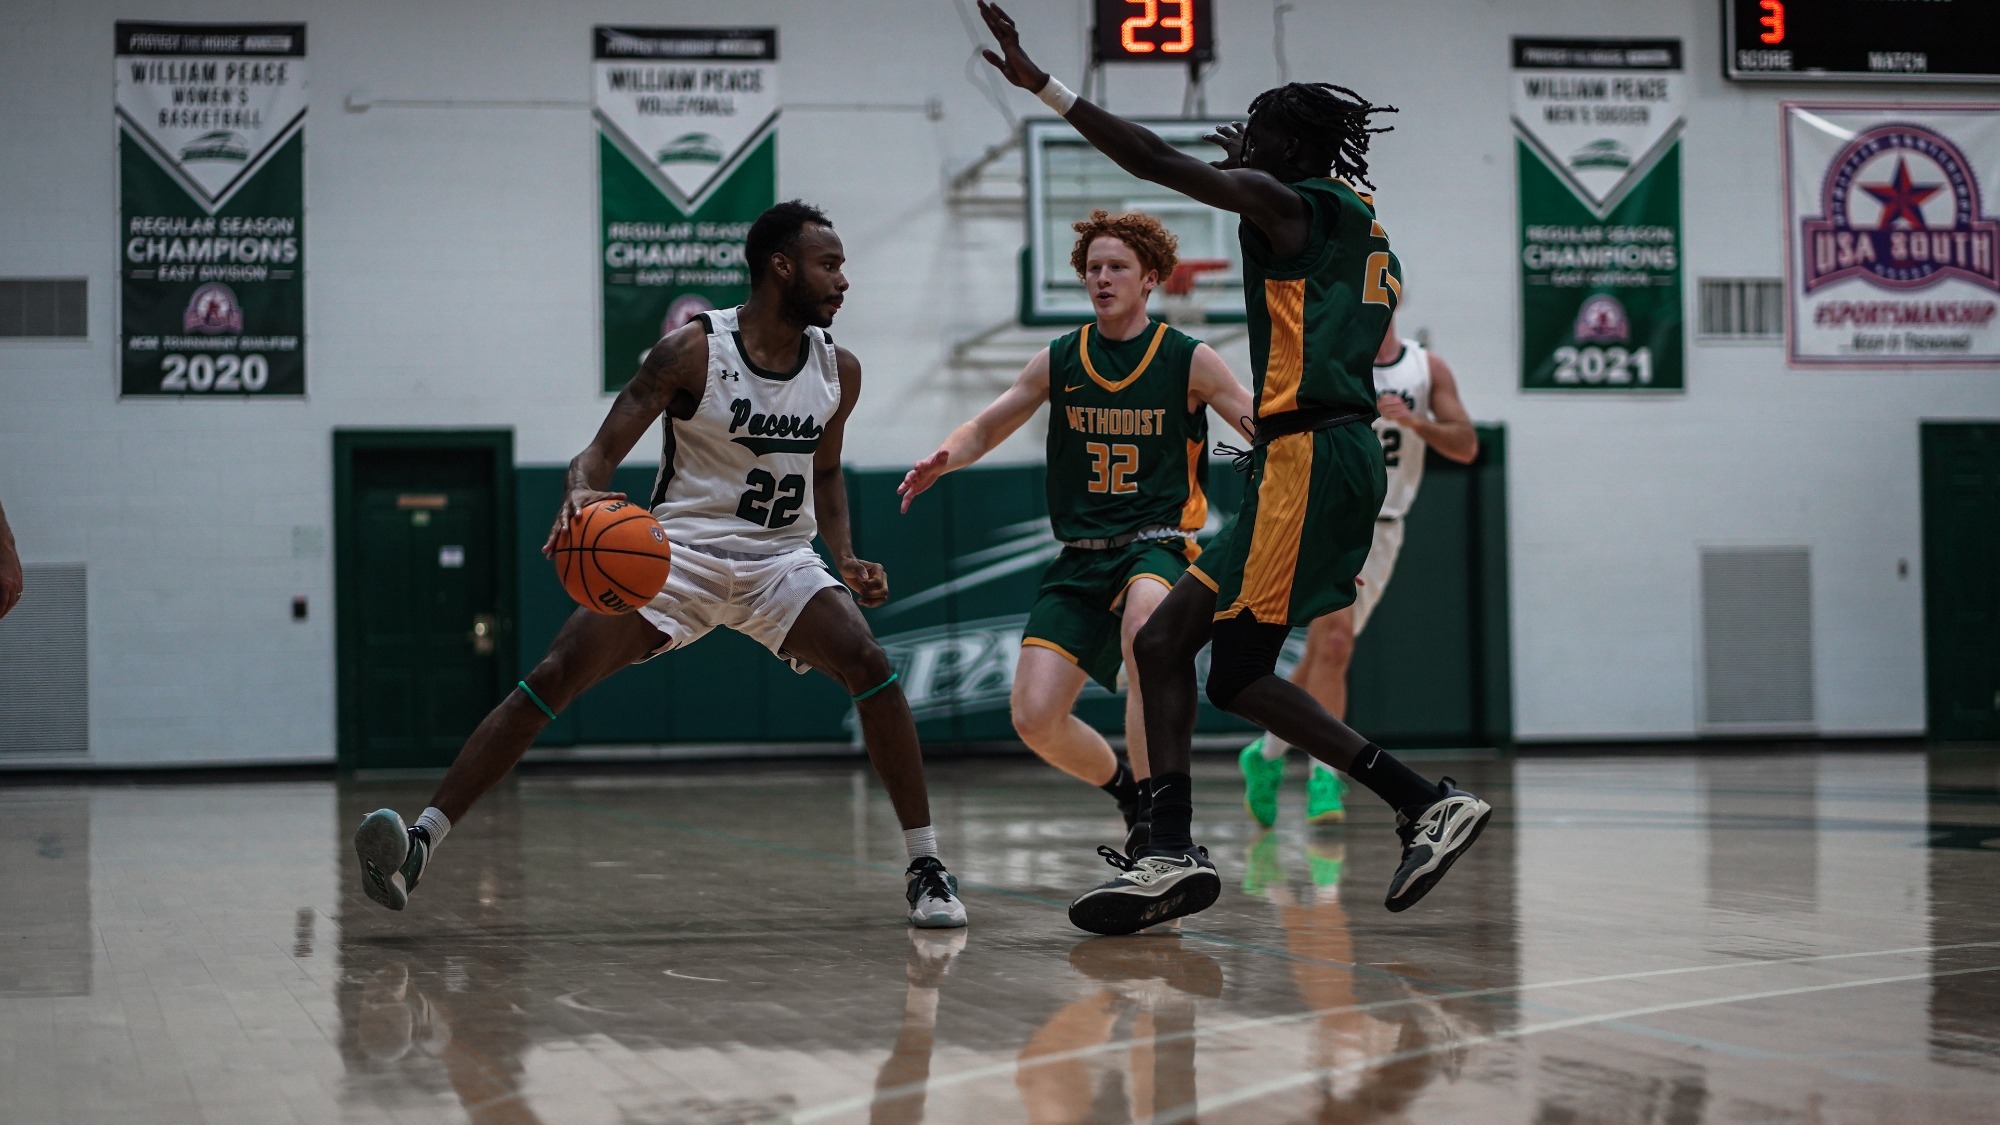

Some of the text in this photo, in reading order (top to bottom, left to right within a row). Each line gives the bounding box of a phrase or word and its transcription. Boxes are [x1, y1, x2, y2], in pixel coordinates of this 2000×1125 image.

[1121, 0, 1194, 53] 23
[1759, 0, 1785, 44] 3
[1738, 49, 1793, 70] SCORE
[1868, 51, 1927, 72] MATCH
[131, 62, 289, 85] WILLIAM PEACE
[607, 68, 763, 93] WILLIAM PEACE
[172, 87, 249, 104] WOMEN'S
[1523, 78, 1668, 101] WILLIAM PEACE
[158, 108, 262, 129] BASKETBALL
[636, 96, 737, 116] VOLLEYBALL
[130, 216, 295, 236] REGULAR SEASON
[608, 222, 694, 241] REGULAR
[1525, 225, 1675, 243] REGULAR SEASON
[127, 237, 298, 263] CHAMPIONS
[1523, 244, 1678, 270] CHAMPIONS
[1816, 231, 1991, 276] USA SOUTH
[158, 264, 268, 282] EAST DIVISION
[635, 268, 674, 286] EAST
[1815, 301, 1996, 328] #SPORTSMANSHIP
[160, 353, 269, 392] 2020
[1553, 345, 1652, 384] 2021
[729, 398, 824, 439] Pacers
[1065, 405, 1166, 435] METHODIST
[1086, 441, 1139, 494] 32
[735, 467, 806, 529] 22
